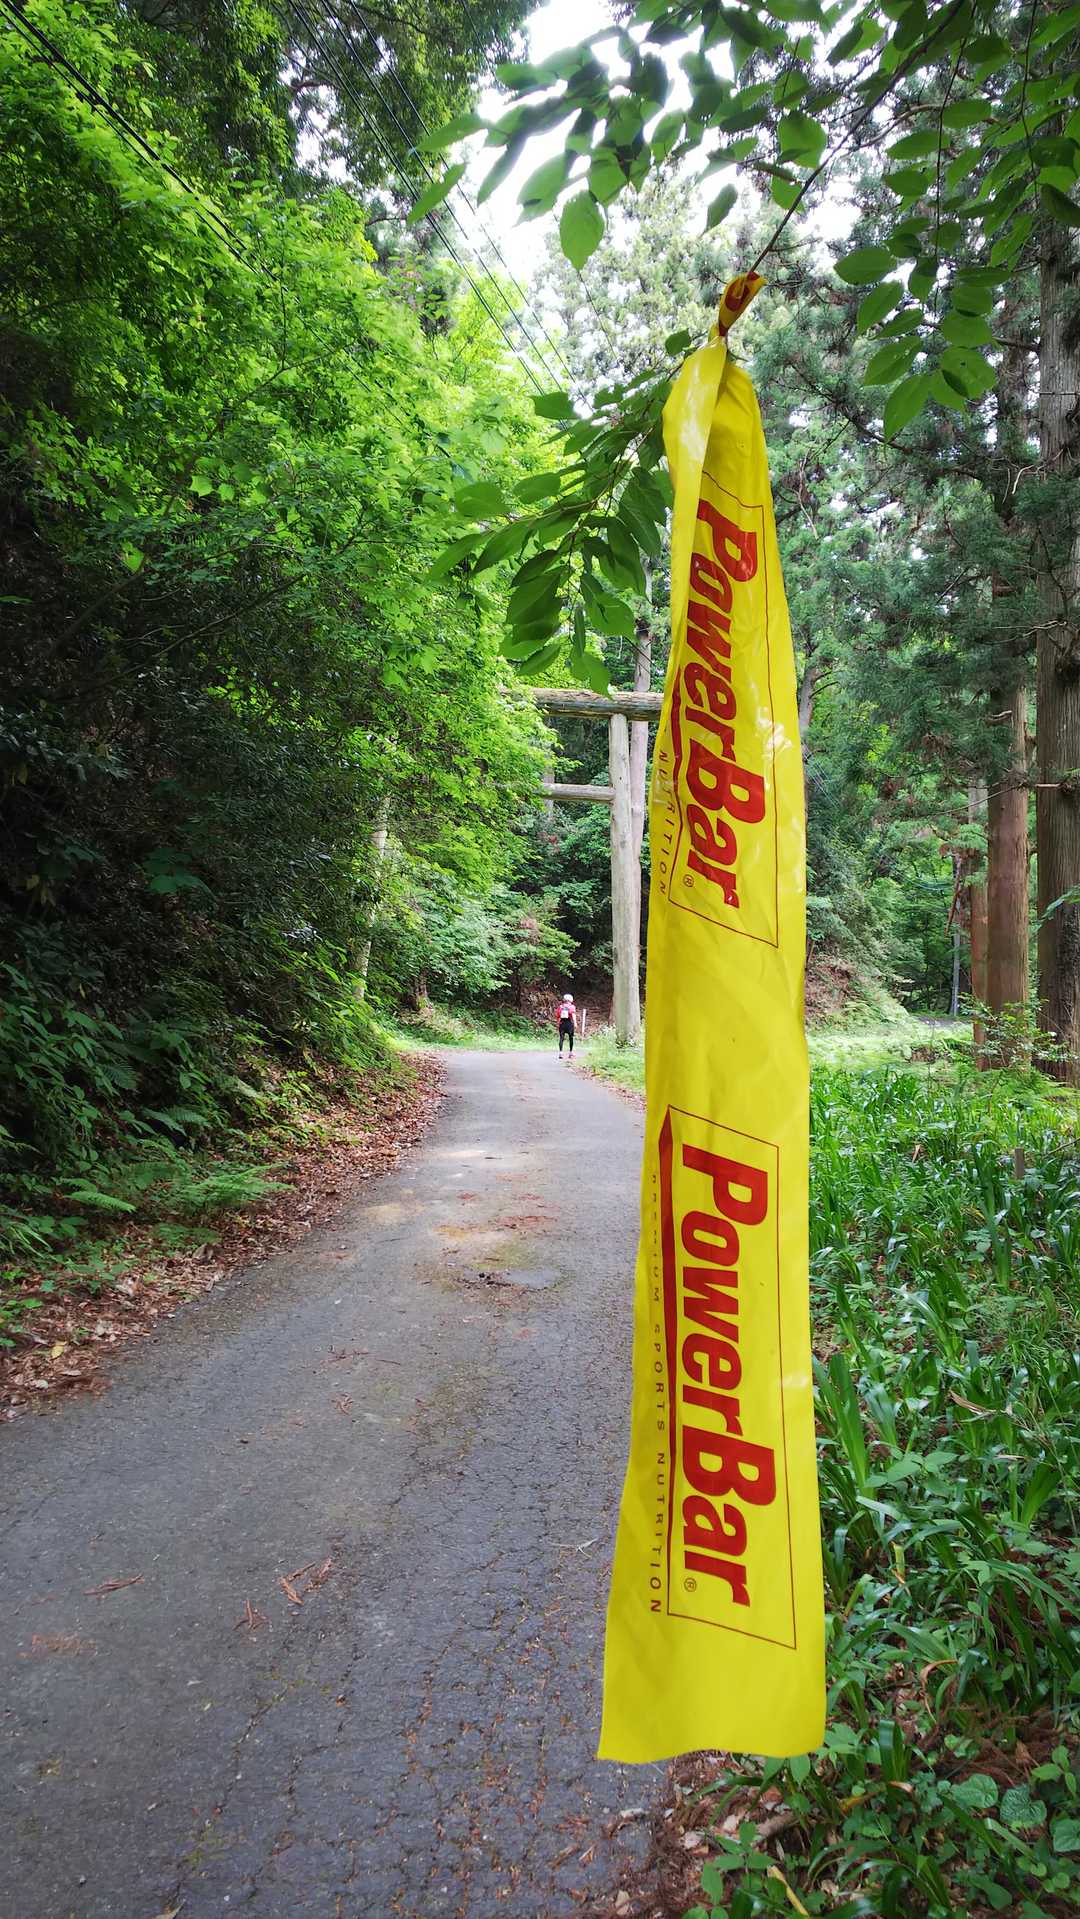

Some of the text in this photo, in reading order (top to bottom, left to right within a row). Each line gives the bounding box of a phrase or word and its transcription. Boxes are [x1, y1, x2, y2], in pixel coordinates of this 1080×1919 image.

[659, 751, 675, 895] NUTRITION
[654, 1323, 665, 1430] SPORTS
[650, 1452, 666, 1612] NUTRITION
